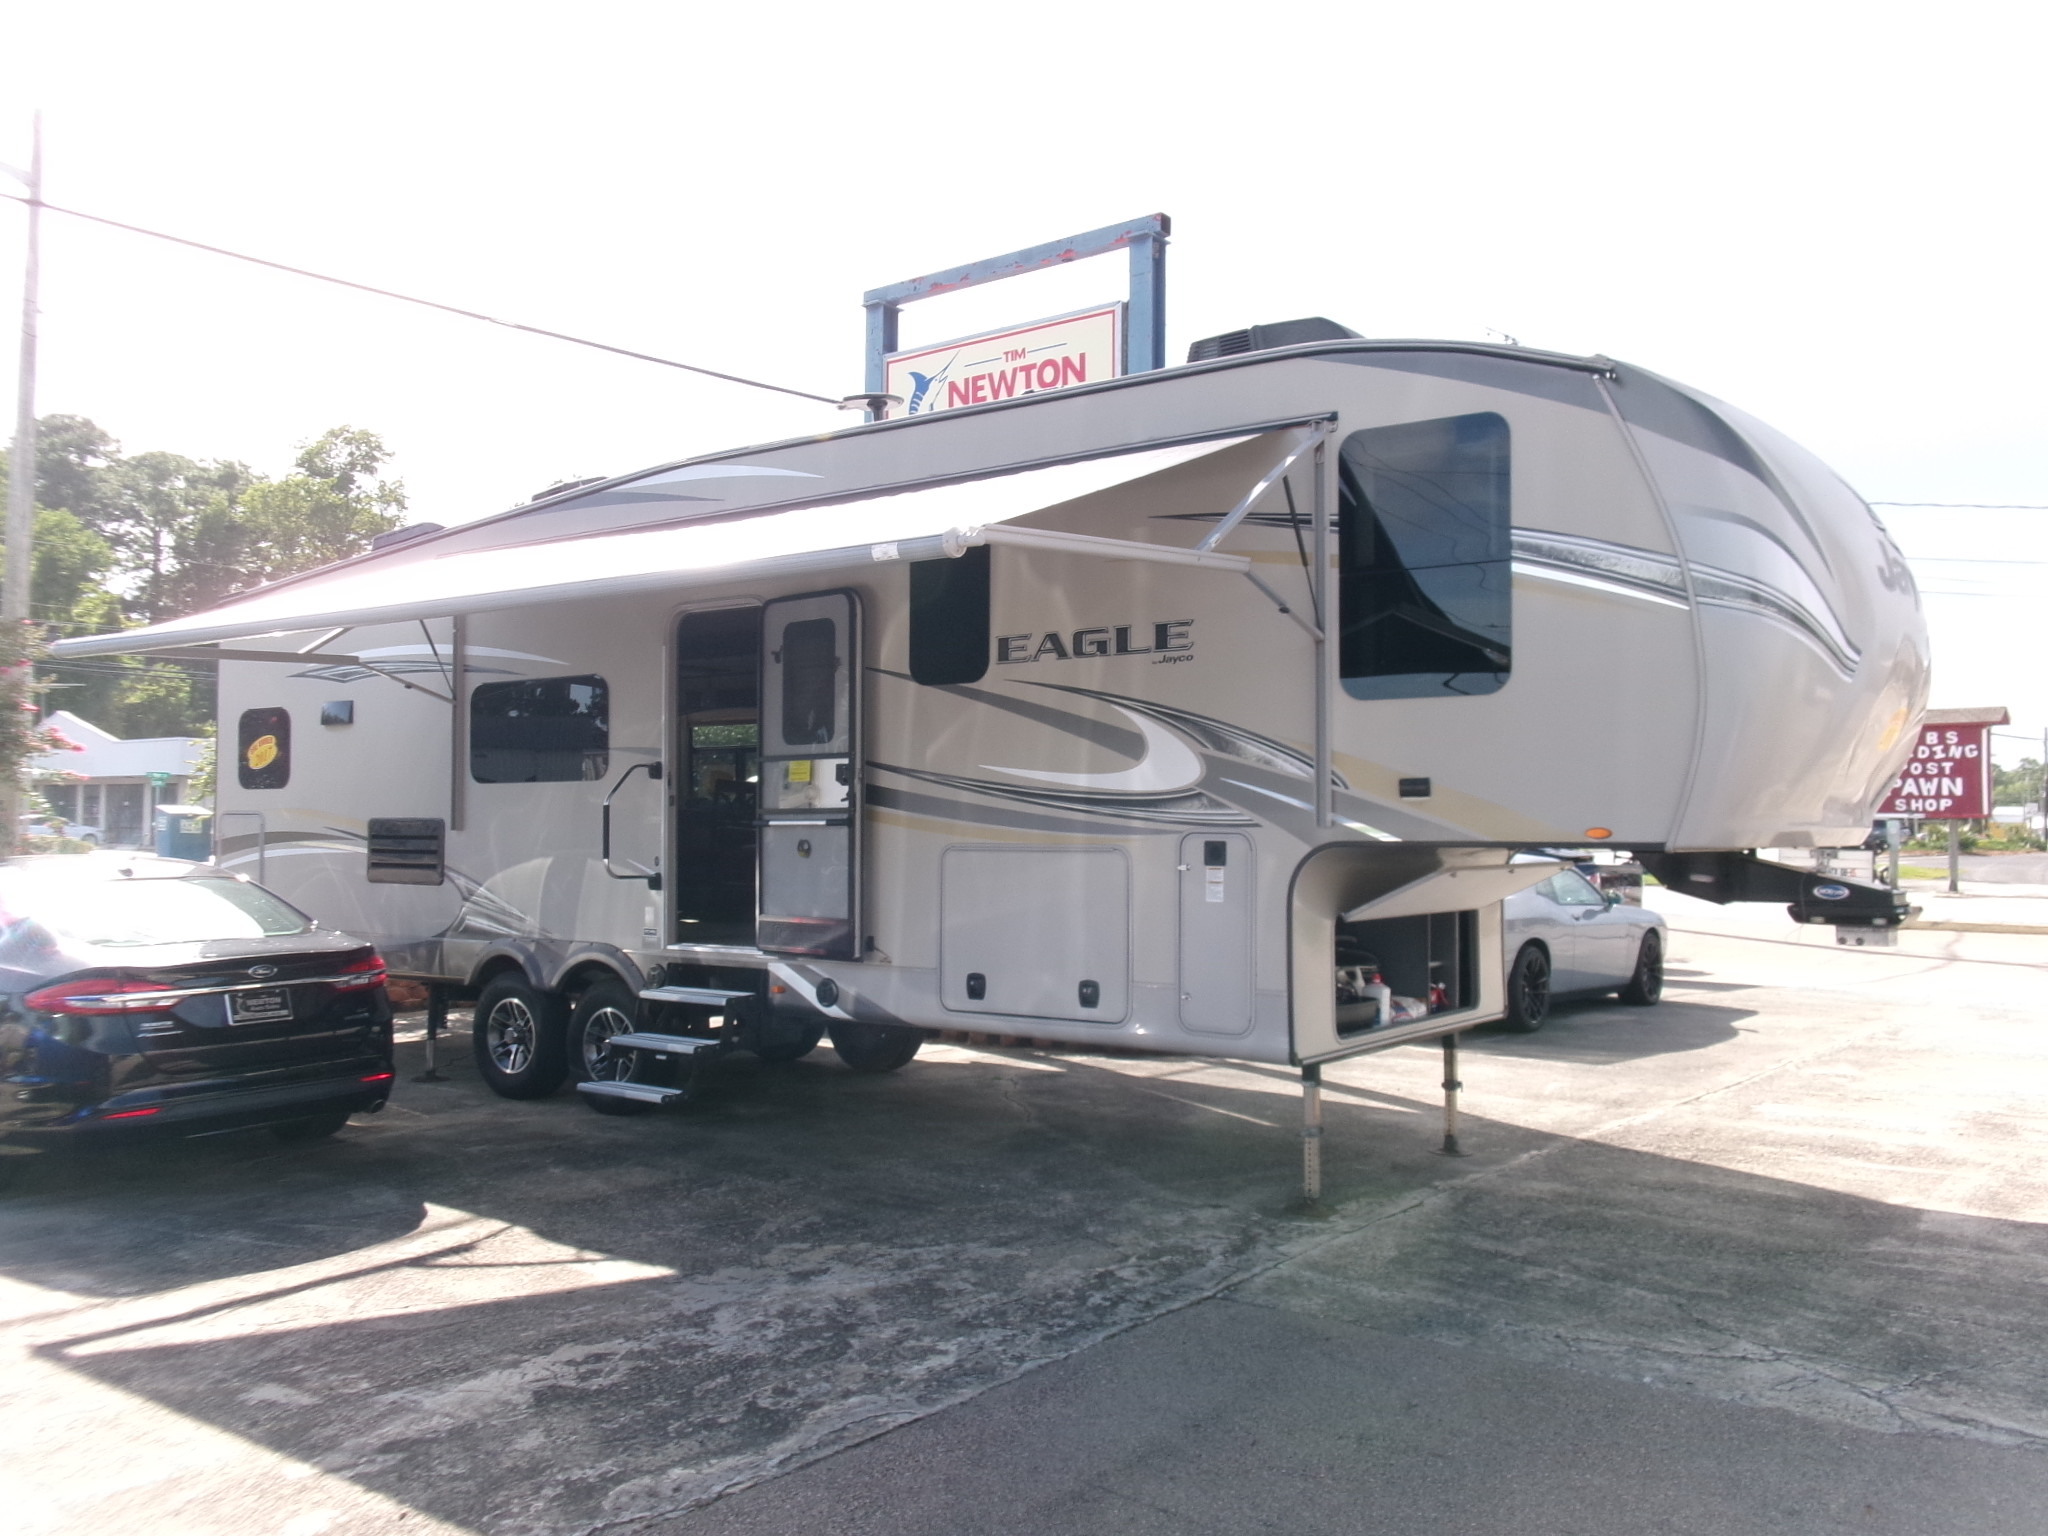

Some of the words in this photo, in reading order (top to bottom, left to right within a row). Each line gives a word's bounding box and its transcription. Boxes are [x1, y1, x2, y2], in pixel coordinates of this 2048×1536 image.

[1003, 347, 1027, 363] TIM
[948, 352, 1086, 408] NEWTON
[995, 618, 1194, 665] EAGLE
[1158, 654, 1194, 664] Jayco
[1916, 744, 1979, 759] DING
[1908, 762, 1954, 775] OST
[1894, 799, 1953, 811] SHOP
